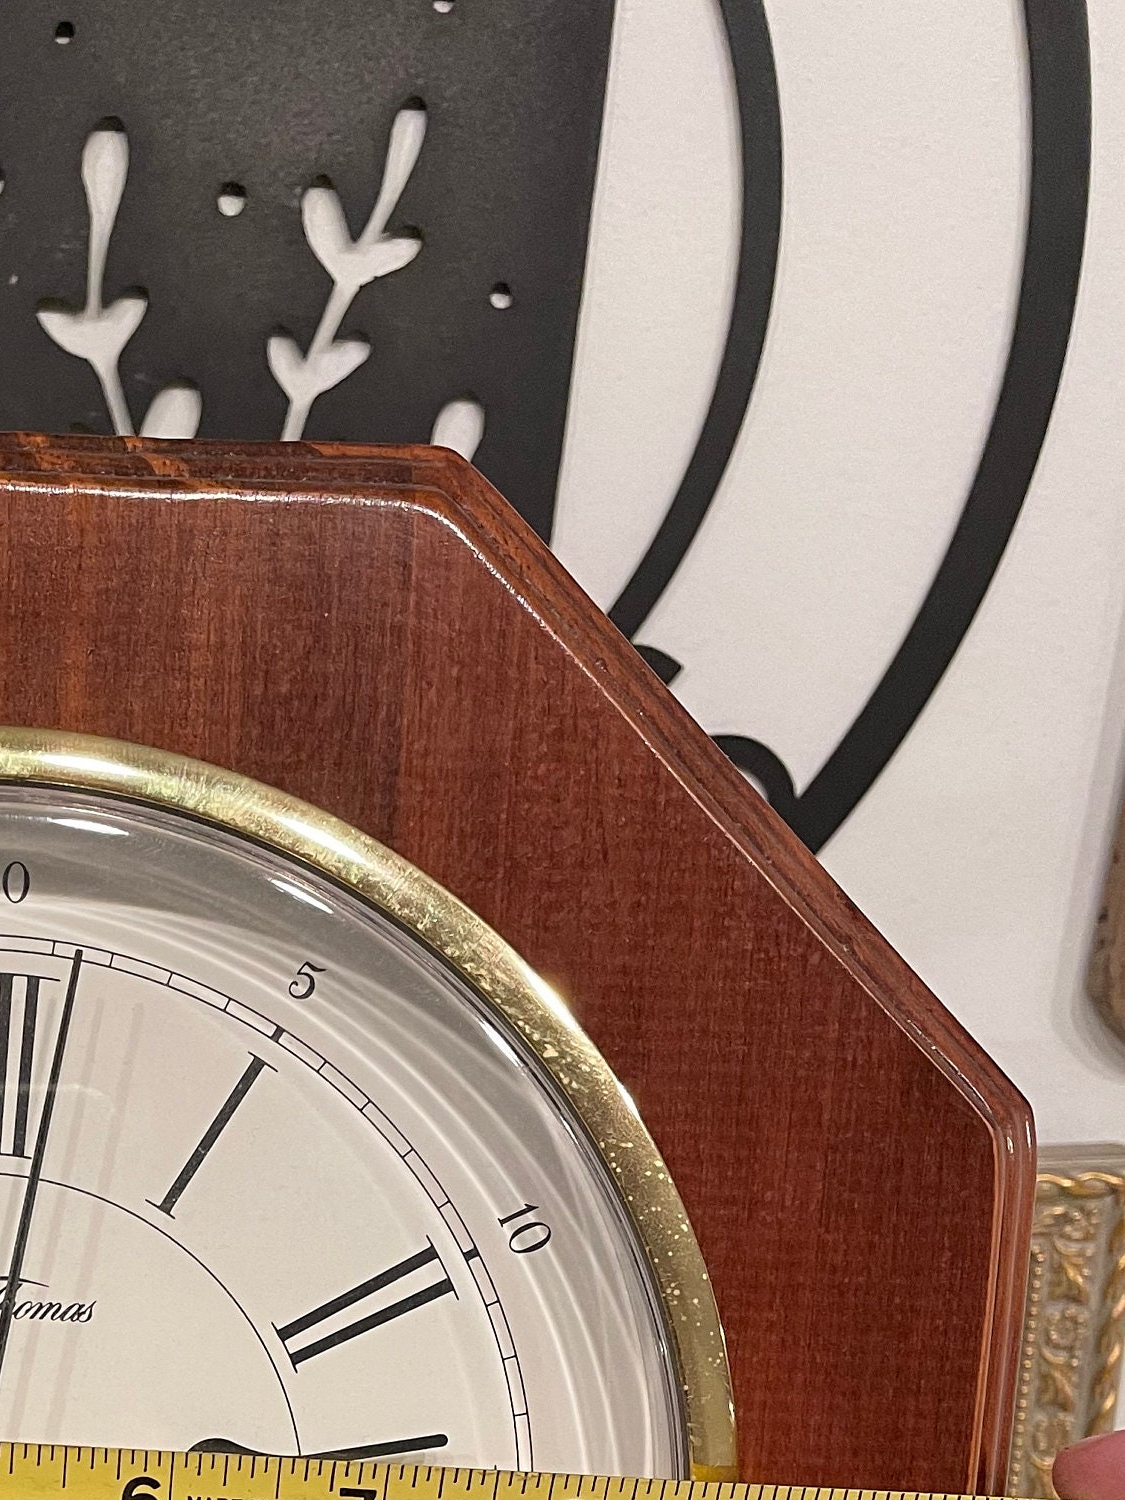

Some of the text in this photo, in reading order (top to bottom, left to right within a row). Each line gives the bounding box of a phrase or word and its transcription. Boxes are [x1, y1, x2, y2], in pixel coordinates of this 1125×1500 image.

[287, 960, 327, 1000] 5
[144, 1050, 278, 1220] I
[497, 1202, 552, 1255] 10
[271, 1234, 460, 1374] II
